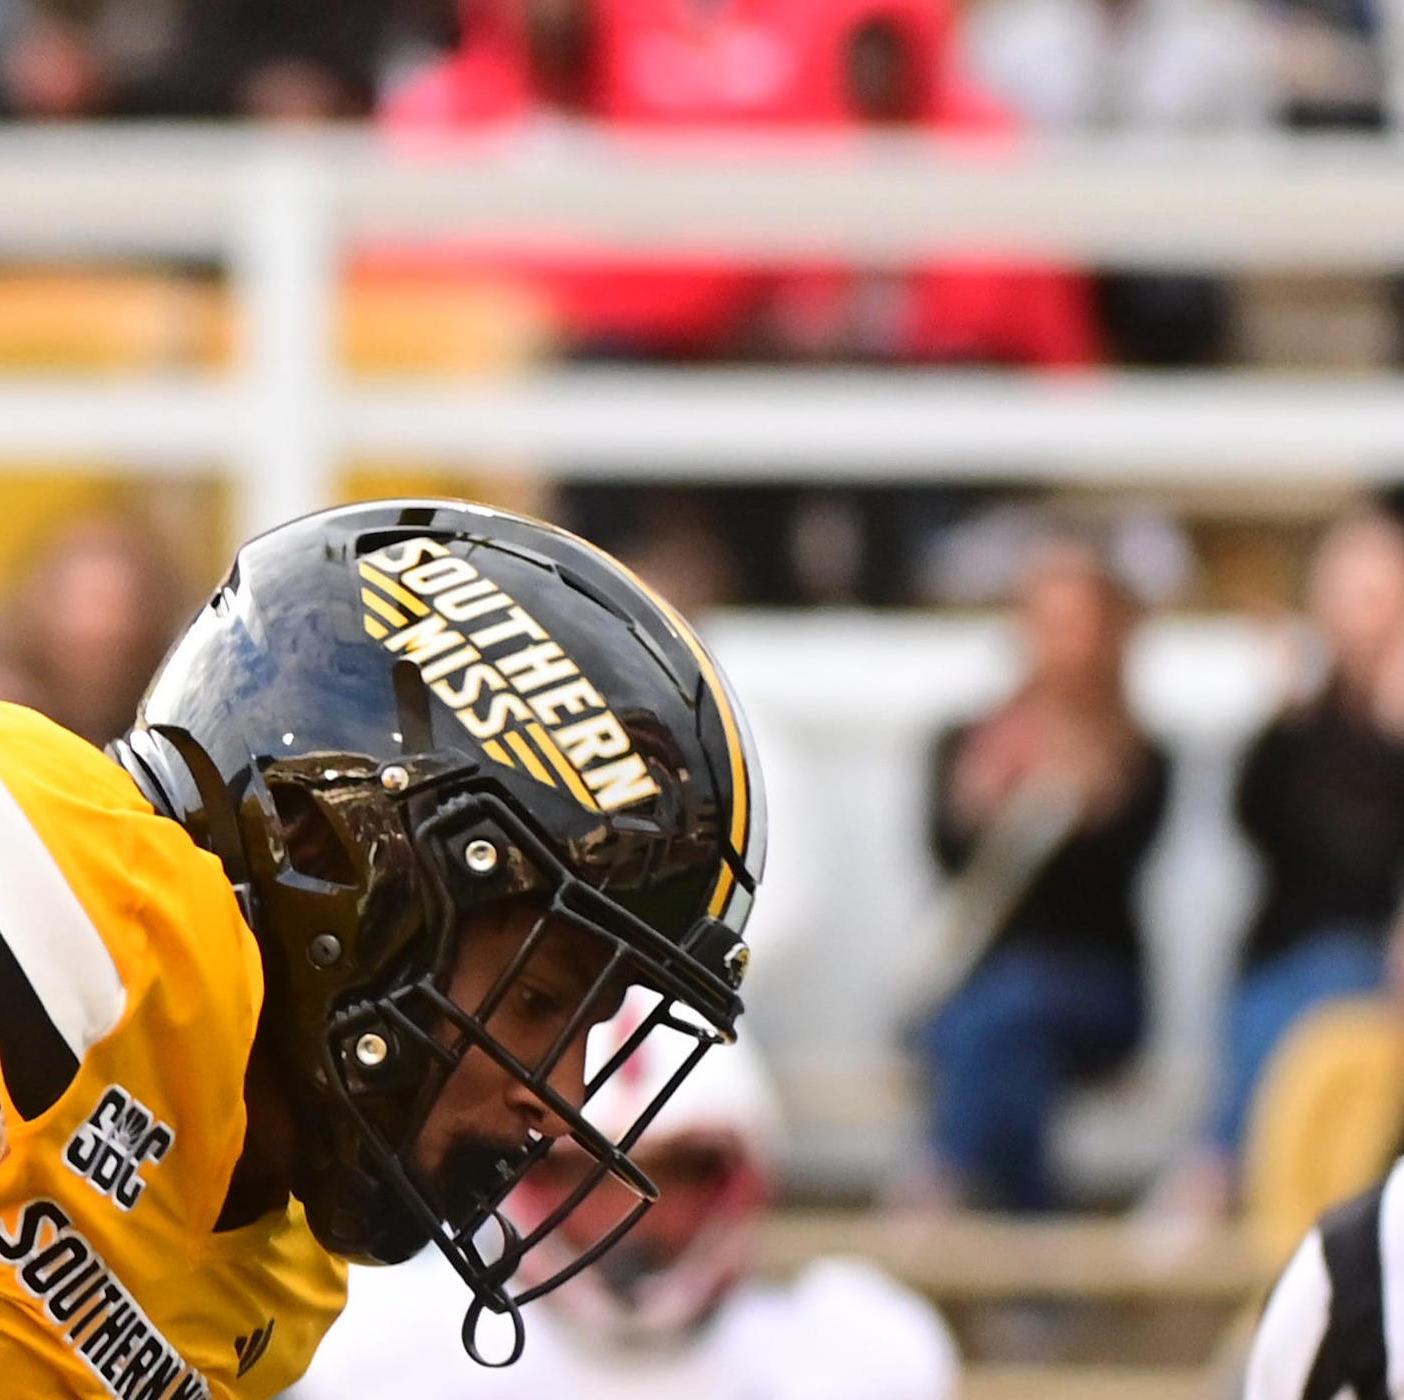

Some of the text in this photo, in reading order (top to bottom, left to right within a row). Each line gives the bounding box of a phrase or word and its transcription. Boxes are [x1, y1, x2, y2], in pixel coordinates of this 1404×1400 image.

[361, 537, 662, 812] SOUTHERN
[383, 613, 535, 740] MISS
[64, 1084, 174, 1211] SBC
